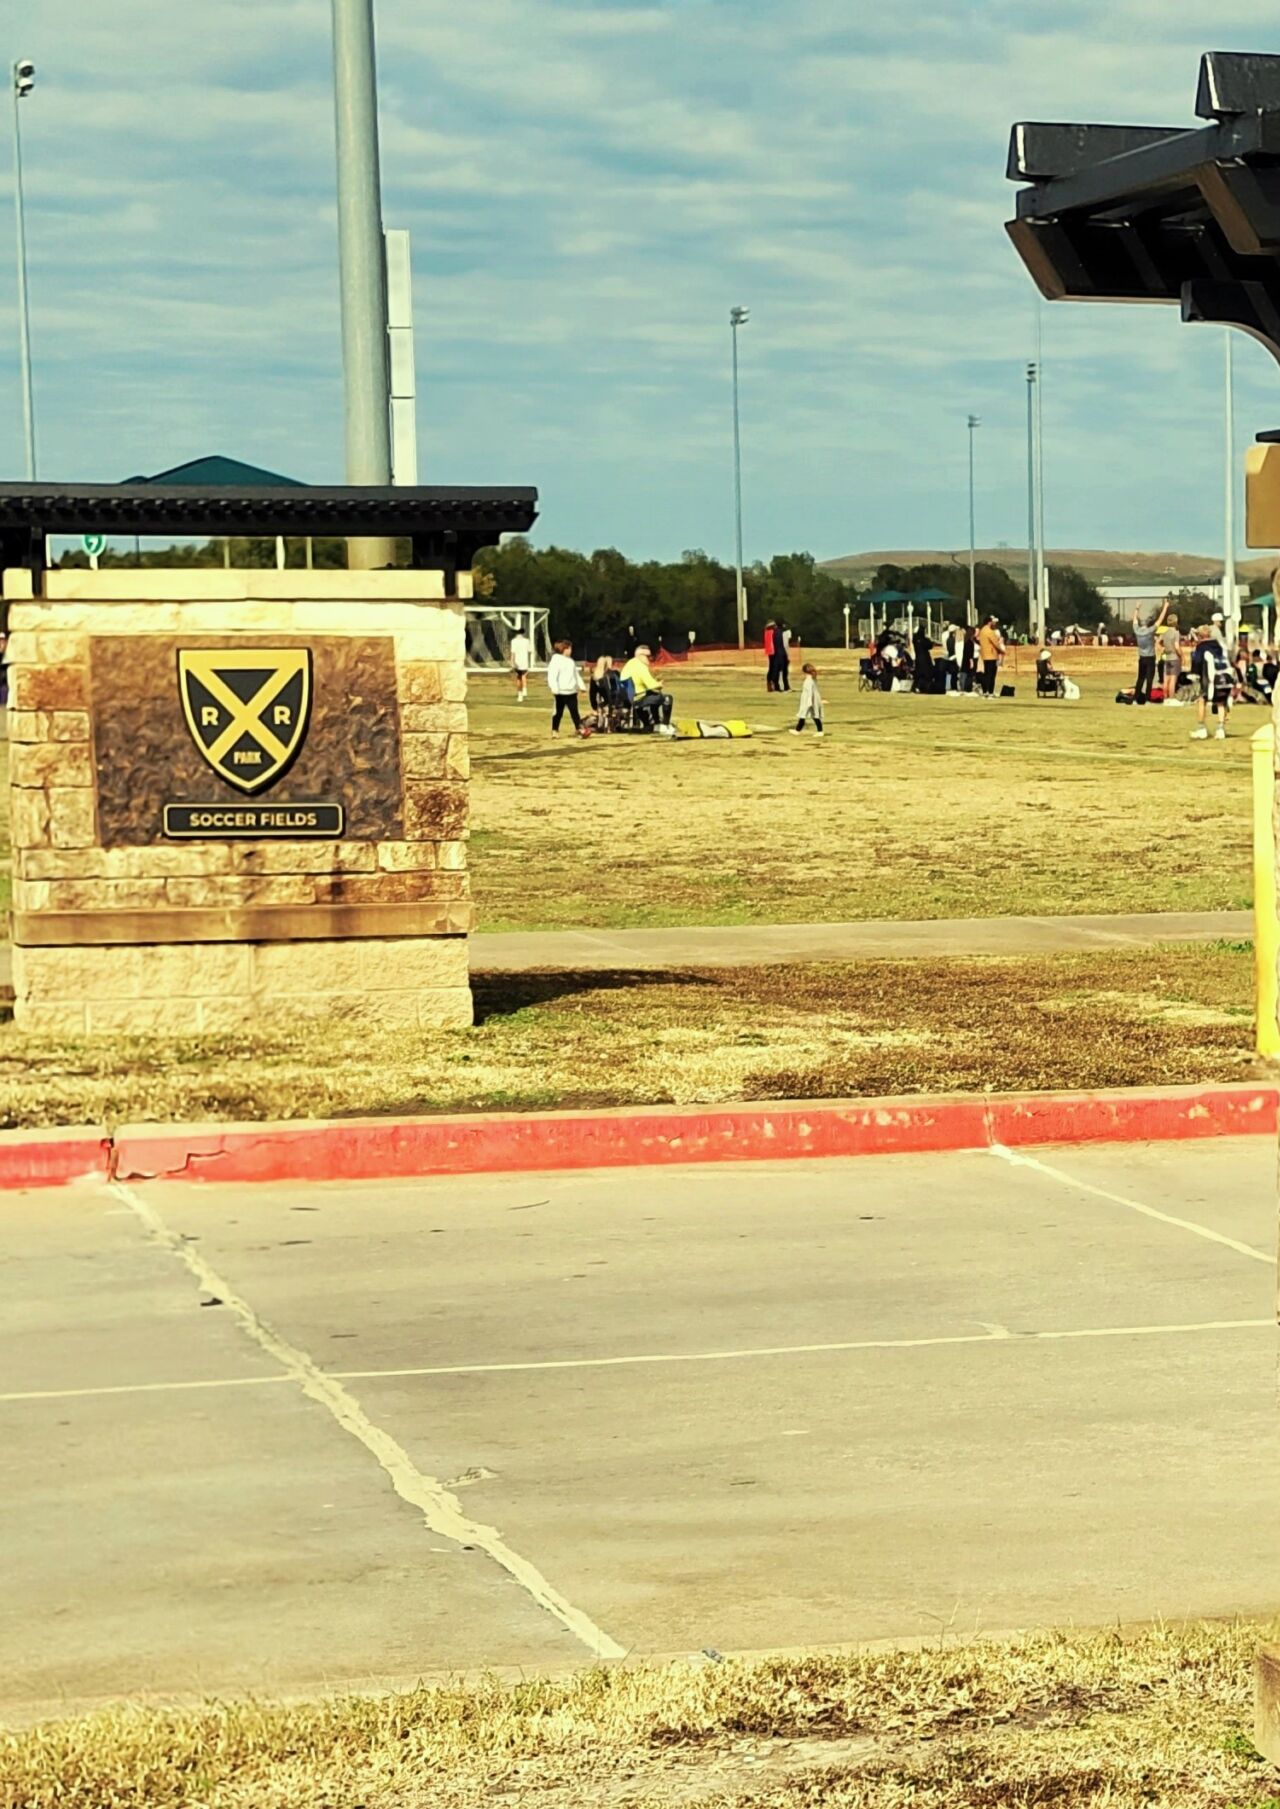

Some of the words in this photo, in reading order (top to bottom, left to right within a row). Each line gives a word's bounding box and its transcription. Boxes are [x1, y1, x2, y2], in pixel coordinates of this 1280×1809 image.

[201, 706, 219, 726] R
[273, 705, 291, 725] R
[233, 751, 262, 764] PARK
[189, 812, 257, 827] SOCCER
[260, 812, 318, 827] FIELDS
